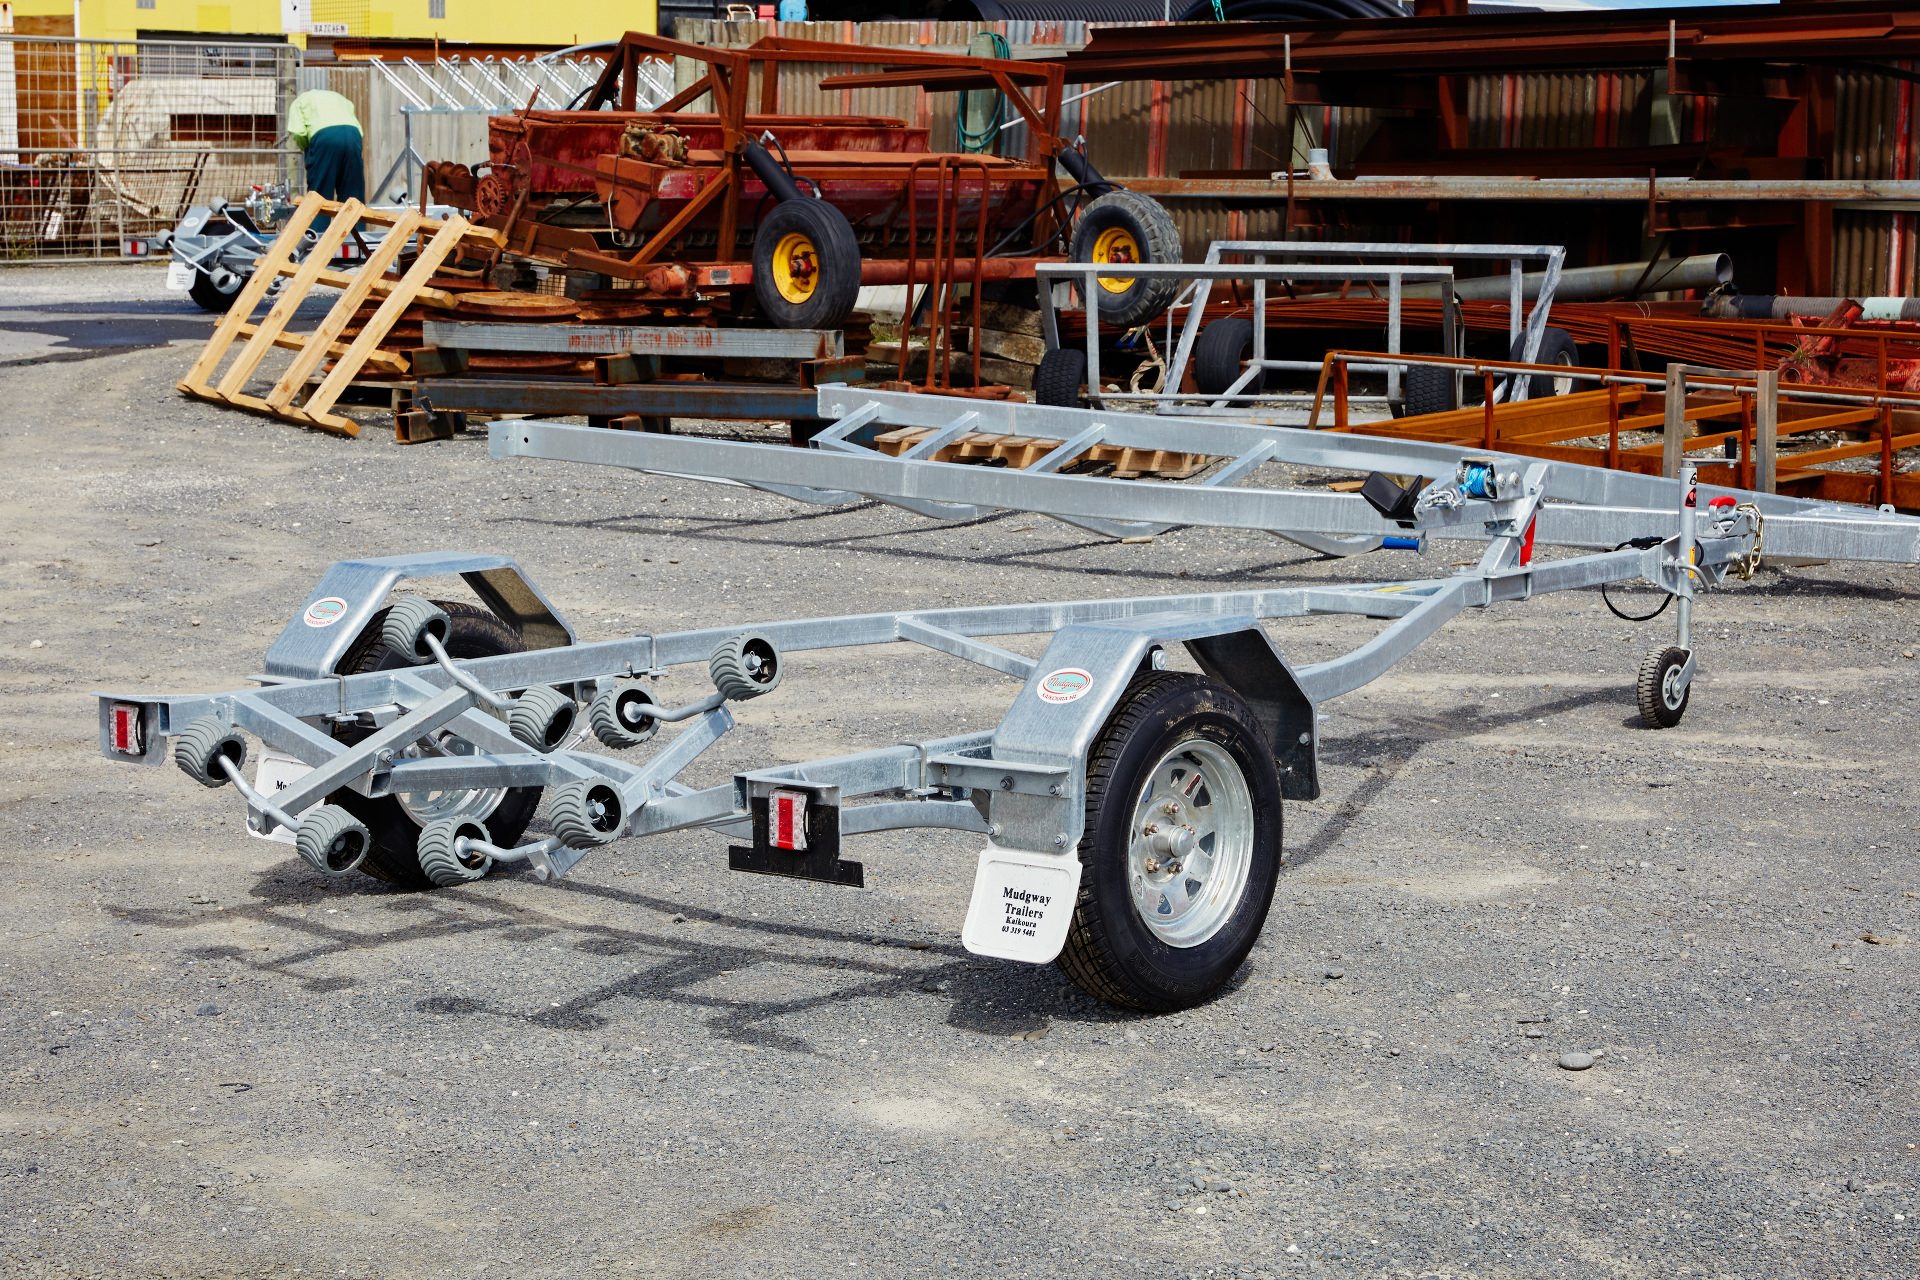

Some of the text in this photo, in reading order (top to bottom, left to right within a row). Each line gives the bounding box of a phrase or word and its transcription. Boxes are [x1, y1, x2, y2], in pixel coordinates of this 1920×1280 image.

[1002, 886, 1052, 907] Mudgway
[1005, 902, 1044, 919] Trailers
[1005, 916, 1037, 928] Kaikoura
[1001, 925, 1010, 933] 03
[1010, 926, 1022, 935] 319
